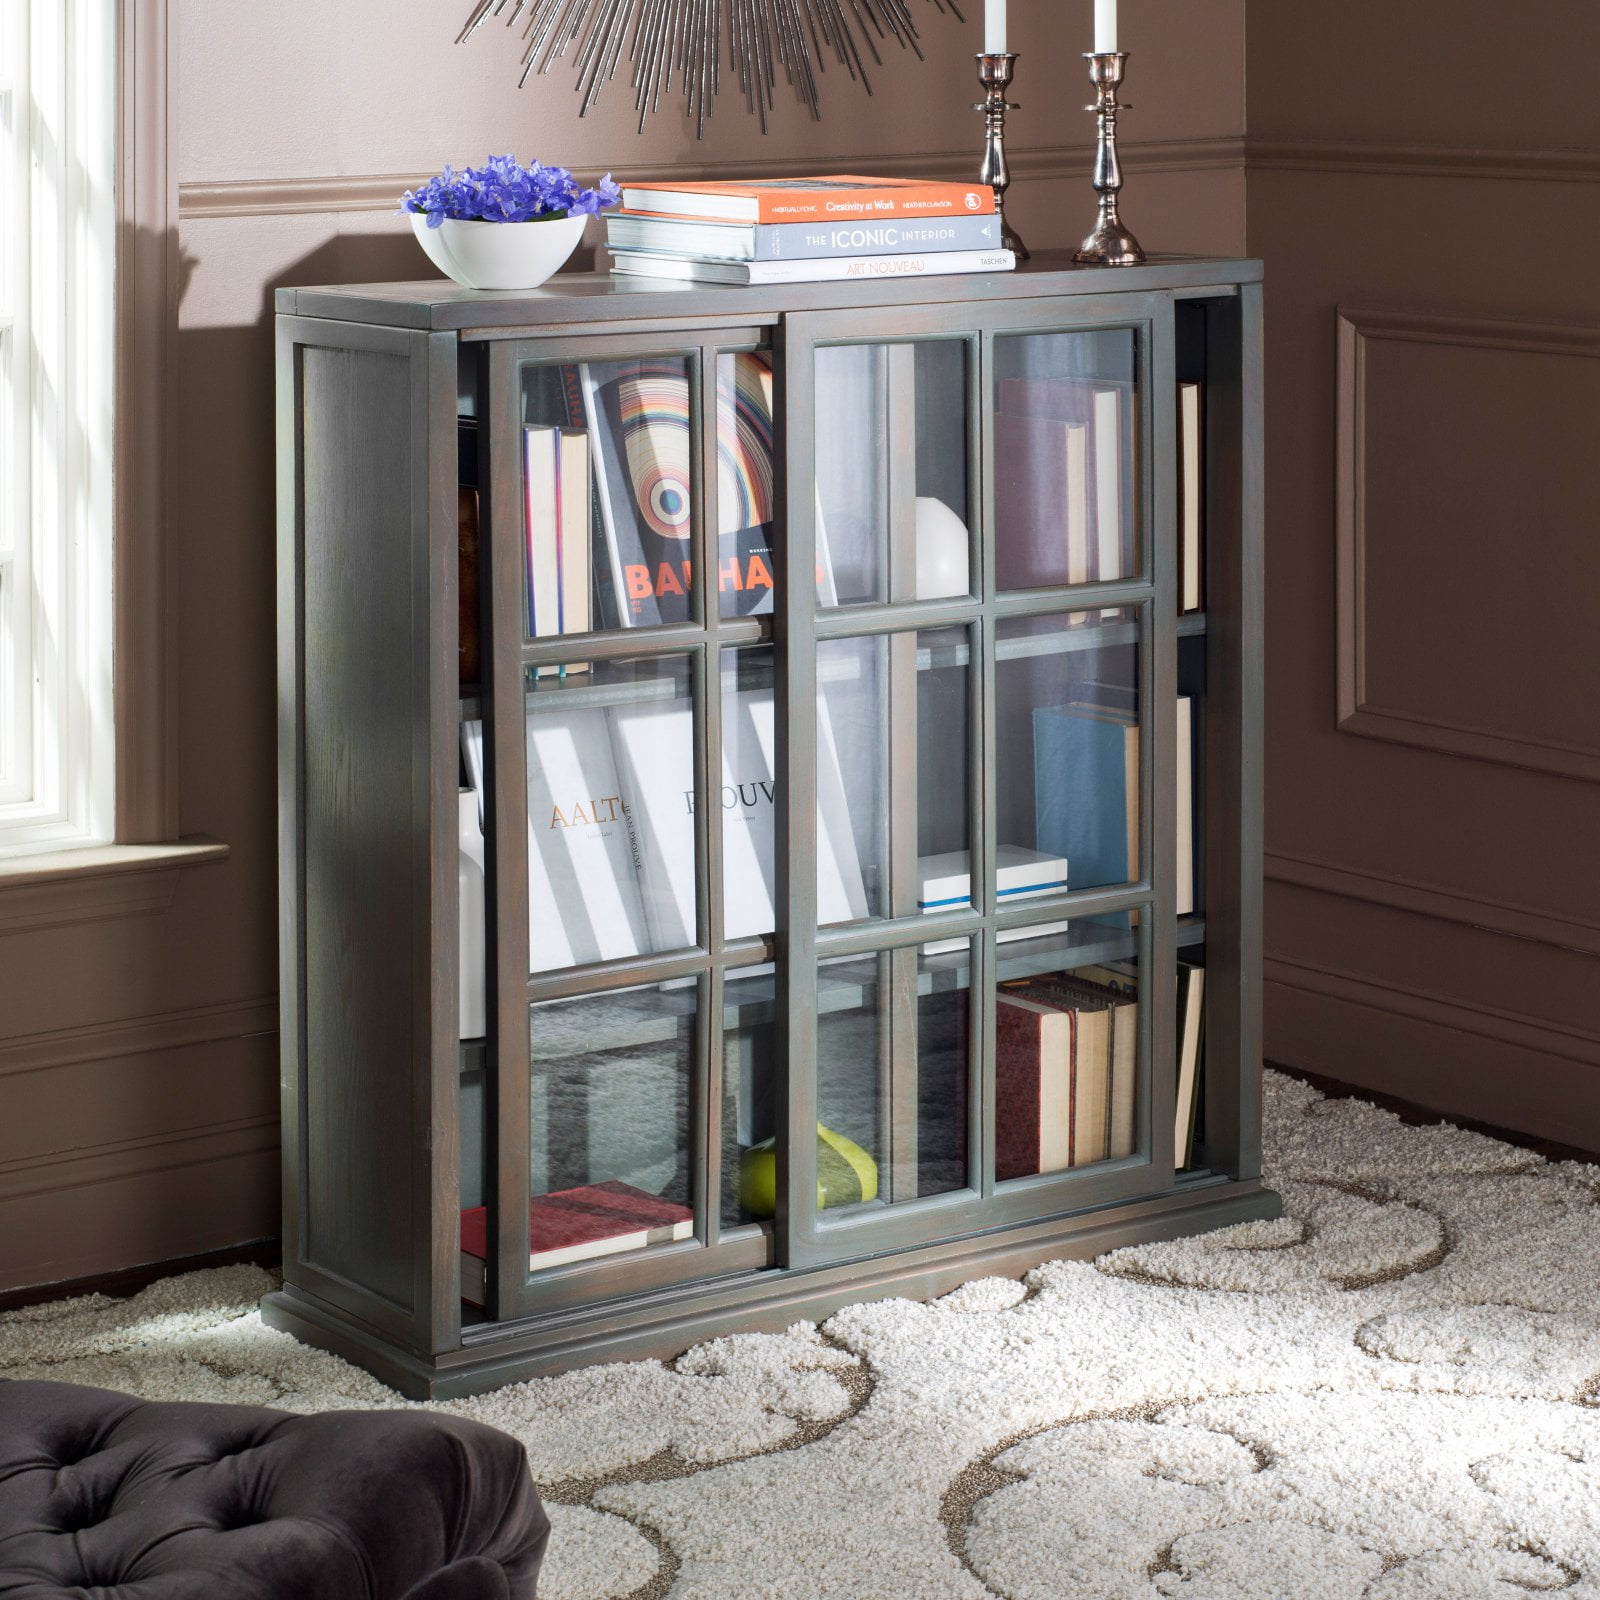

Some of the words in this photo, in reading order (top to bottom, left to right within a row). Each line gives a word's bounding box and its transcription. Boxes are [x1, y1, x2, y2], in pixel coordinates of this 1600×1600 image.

[825, 201, 864, 212] Creativity
[874, 200, 895, 210] Work
[805, 235, 827, 246] THE
[831, 228, 898, 248] ICONIC
[902, 229, 956, 241] INTERIOR
[846, 263, 866, 275] ART
[869, 260, 925, 275] NOUVEAU
[980, 257, 1008, 265] TASCHEN
